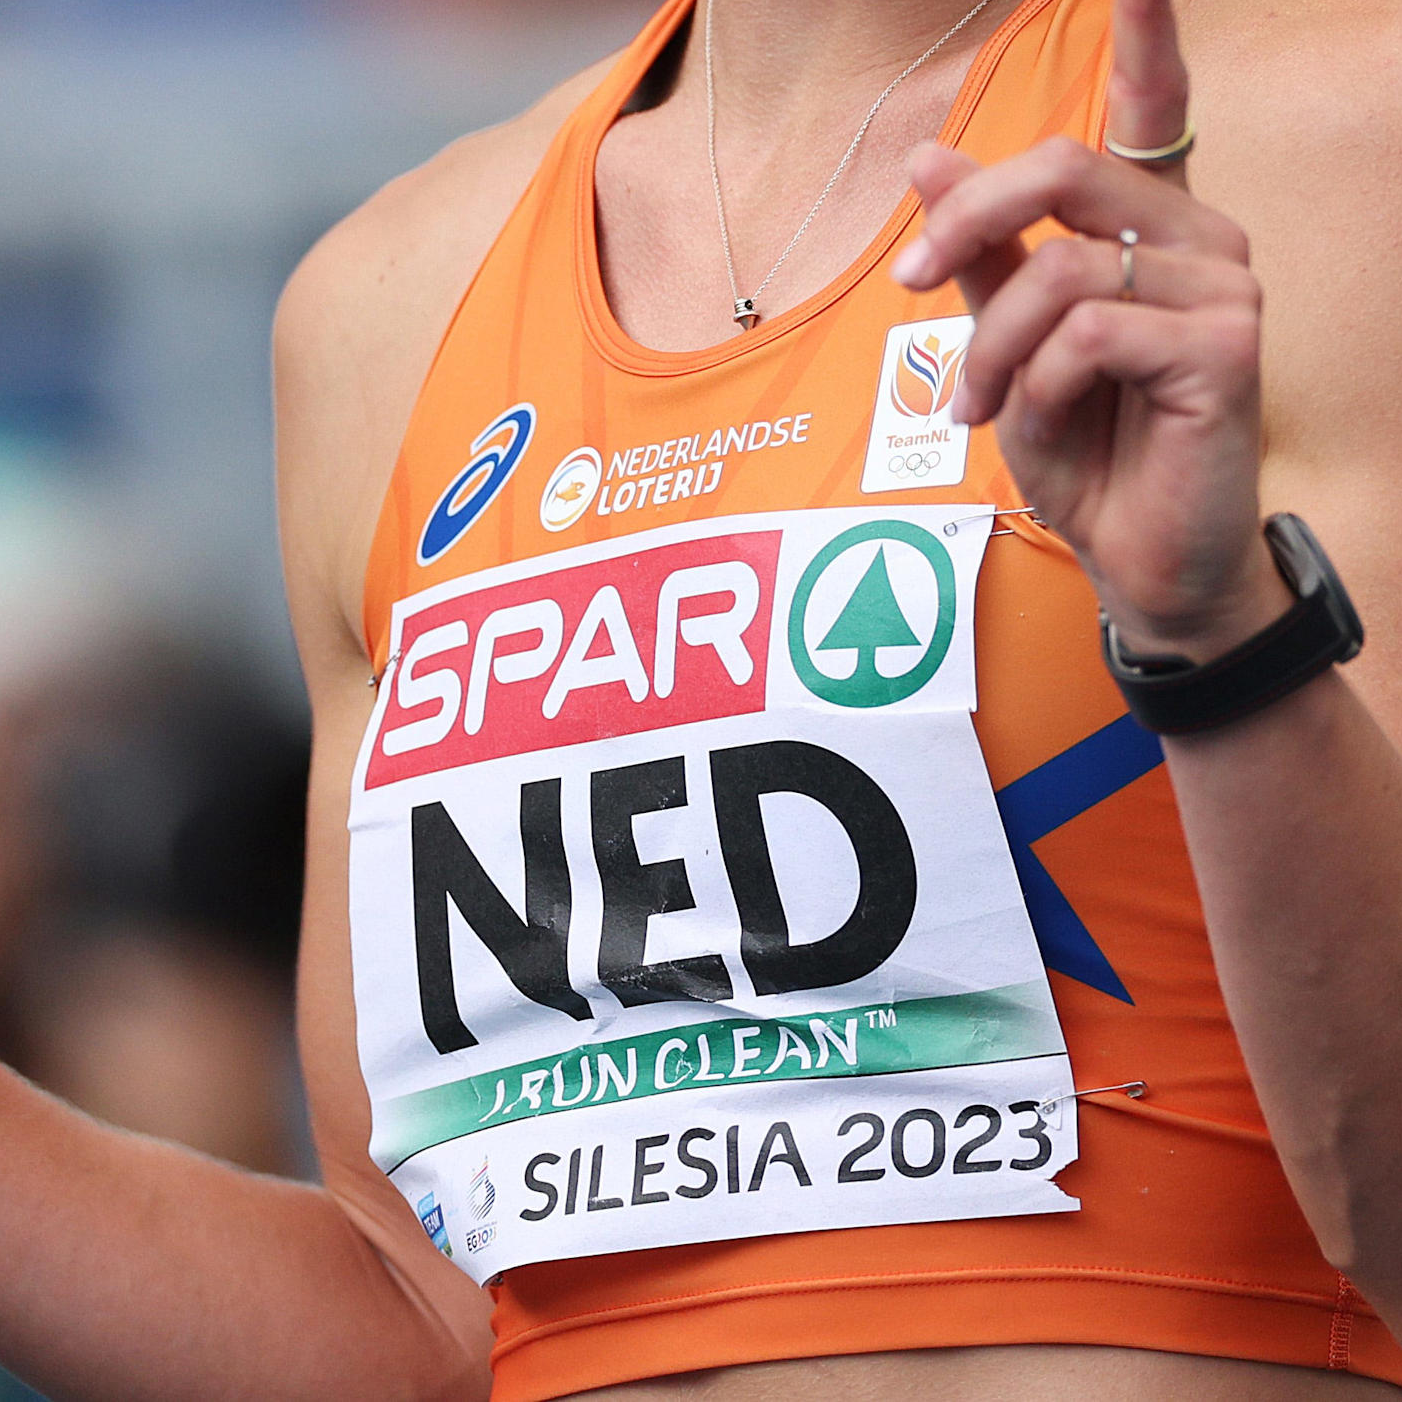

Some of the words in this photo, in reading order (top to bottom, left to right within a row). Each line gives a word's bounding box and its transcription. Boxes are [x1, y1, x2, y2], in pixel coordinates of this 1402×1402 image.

[605, 412, 813, 481] NEDERLANDSE
[886, 428, 951, 449] TeamNL
[596, 460, 724, 517] LOTERIJ
[381, 560, 760, 756] SPAR
[410, 739, 918, 1055] NED
[518, 1120, 814, 1224] SILESIA
[836, 1100, 1053, 1184] 2023
